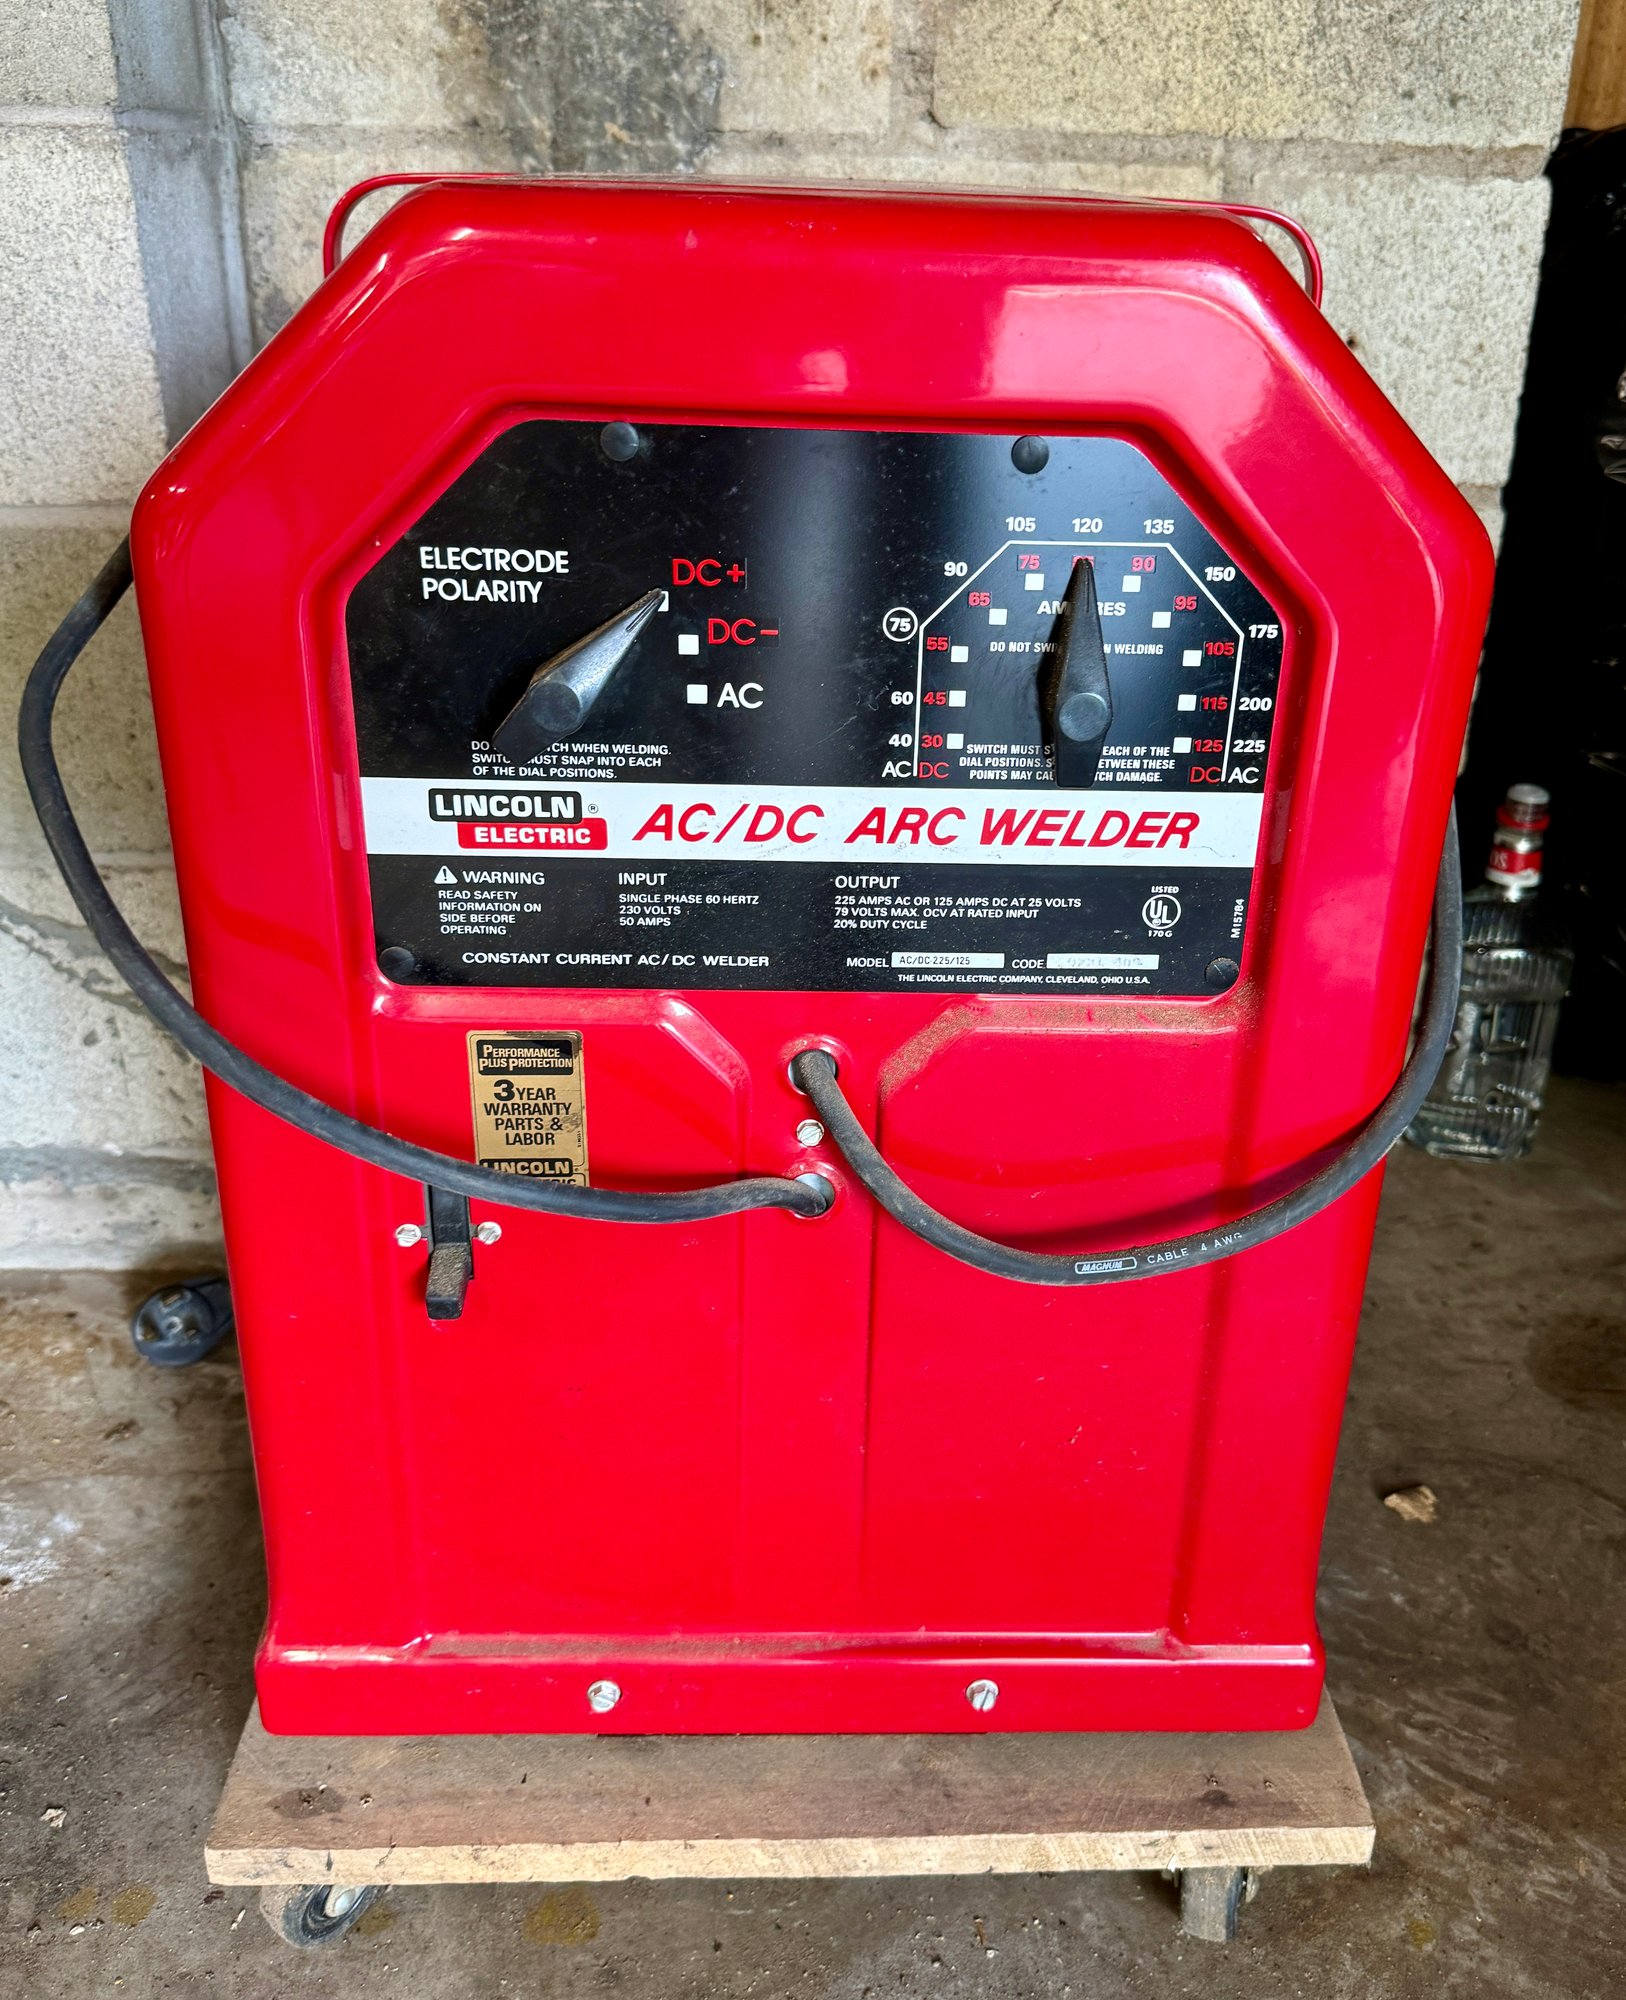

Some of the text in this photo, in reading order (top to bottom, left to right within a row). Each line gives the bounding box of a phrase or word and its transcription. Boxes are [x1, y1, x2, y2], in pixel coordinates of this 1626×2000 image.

[1005, 517, 1036, 533] 105
[1071, 518, 1103, 534] 120
[1143, 519, 1175, 535] 135
[419, 546, 569, 574] ELECTRODE
[1018, 555, 1041, 570] 75
[1131, 556, 1155, 572] 90
[671, 559, 745, 586] DC+
[943, 562, 968, 577] 90
[1205, 566, 1236, 582] 150
[422, 578, 543, 603] POLARITY
[968, 592, 991, 607] 65
[1175, 596, 1198, 611] 95
[888, 618, 912, 633] 75
[1248, 624, 1279, 639] 175
[926, 637, 949, 652] 55
[990, 641, 1005, 652] DO
[1009, 642, 1031, 653] NOT
[1114, 644, 1164, 655] WELDING
[1205, 642, 1235, 657] 105
[716, 683, 764, 709] AC
[890, 692, 914, 706] 60
[924, 692, 946, 706] 45
[1201, 696, 1228, 711] 115
[1238, 697, 1272, 712] 200
[471, 741, 490, 751] DO
[572, 743, 609, 754] WHEN
[612, 744, 672, 755] WELDING.
[888, 734, 913, 748] 40
[921, 734, 944, 749] 30
[1194, 739, 1224, 753] 125
[1233, 740, 1266, 754] 225
[967, 744, 1007, 754] SWITCH
[1010, 745, 1040, 755] MUST
[1102, 746, 1130, 756] EACH
[1133, 746, 1147, 756] OF
[1150, 746, 1170, 756] THE
[561, 756, 594, 766] SNAP
[597, 756, 626, 766] INTO
[628, 757, 662, 767] EACH
[959, 757, 982, 767] DIAL
[985, 757, 1044, 768] POSITIONS.
[1097, 759, 1141, 769] ETWEEN
[1143, 759, 1175, 770] THESE
[473, 765, 618, 779] OF THE DIAL POSITIONS.
[881, 761, 912, 779] AC
[919, 762, 949, 779] DC
[969, 770, 1008, 780] POINTS
[1010, 770, 1033, 780] MAY
[1116, 772, 1163, 782] DAMAGE.
[1190, 767, 1221, 783] DC
[1228, 767, 1259, 783] AC
[434, 793, 576, 819] LINCOLN
[632, 803, 1200, 850] AC/DC ARC WELDER
[474, 827, 591, 844] ELECTRIC
[462, 871, 545, 885] WARNING
[618, 873, 667, 886] INPUT
[834, 875, 900, 889] OUTPUT
[438, 890, 518, 900] READ SAFETY
[1151, 885, 1179, 893] LISTED
[619, 894, 759, 905] SINGLE PHASE 60 HERTZ
[835, 896, 1081, 908] 225 AMPS AC OR 125 AMPS DC AT 25 VOLTS
[439, 901, 542, 913] INFORMATION ON
[619, 906, 681, 916] 230 VOLTS
[835, 907, 1039, 919] 79 VOLTS MAX. OCV AT RATED INPUT
[440, 913, 516, 924] SIDE BEFORE
[619, 917, 671, 927] 50 AMPS
[833, 920, 928, 930] 20% DUTY CYCLE
[1230, 899, 1245, 939] M15784
[440, 925, 506, 935] OPERATING
[462, 953, 550, 965] CONSTANT
[556, 953, 632, 966] CURRENT
[703, 955, 769, 967] WELDER
[846, 957, 889, 968] MODEL
[1011, 959, 1045, 969] CODE
[898, 974, 915, 982] THE
[917, 974, 955, 982] LINCOLN
[956, 974, 997, 983] ELECTRIC
[998, 975, 1044, 984] COMPANY,
[1100, 976, 1124, 984] OHIO
[493, 1079, 556, 1101] 3 YEAR
[484, 1102, 572, 1116] WARRANTY
[495, 1117, 563, 1131] PARTS &
[505, 1132, 556, 1146] LABOR
[1081, 1232, 1243, 1272] MAGNUM CABLE 4 AWG
